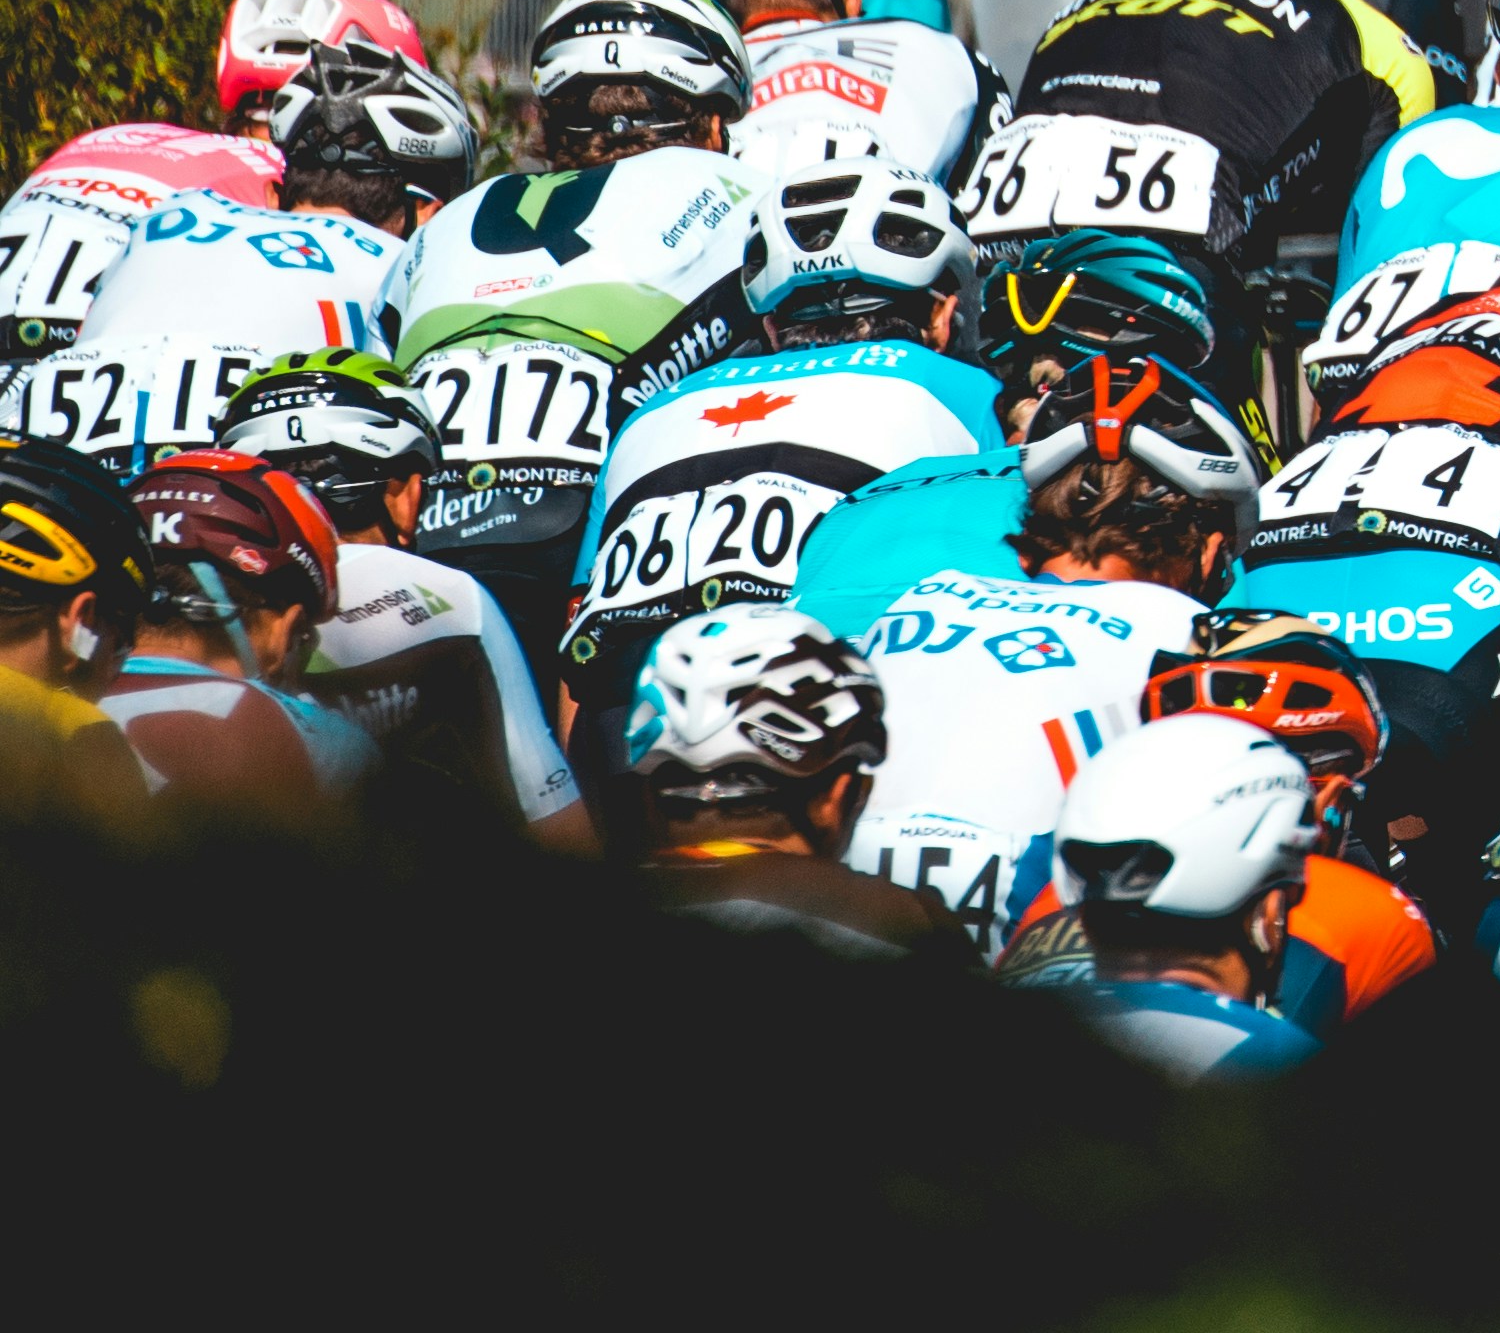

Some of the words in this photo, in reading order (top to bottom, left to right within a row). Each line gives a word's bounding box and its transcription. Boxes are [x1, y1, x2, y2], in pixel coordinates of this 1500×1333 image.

[575, 22, 654, 35] OAKLEY
[660, 65, 699, 92] Deloitte
[968, 137, 1036, 217] 56
[1095, 145, 1176, 213] 56
[146, 208, 233, 244] DJ
[662, 188, 716, 249] dimension
[702, 200, 731, 230] data
[474, 277, 532, 297] SPAR
[251, 391, 336, 414] OAKLEY
[486, 358, 602, 452] 172
[756, 476, 808, 496] WALSH
[1422, 445, 1476, 508] 4
[133, 491, 215, 504] OAKLEY
[152, 512, 185, 544] K
[1272, 712, 1347, 728] RUDY
